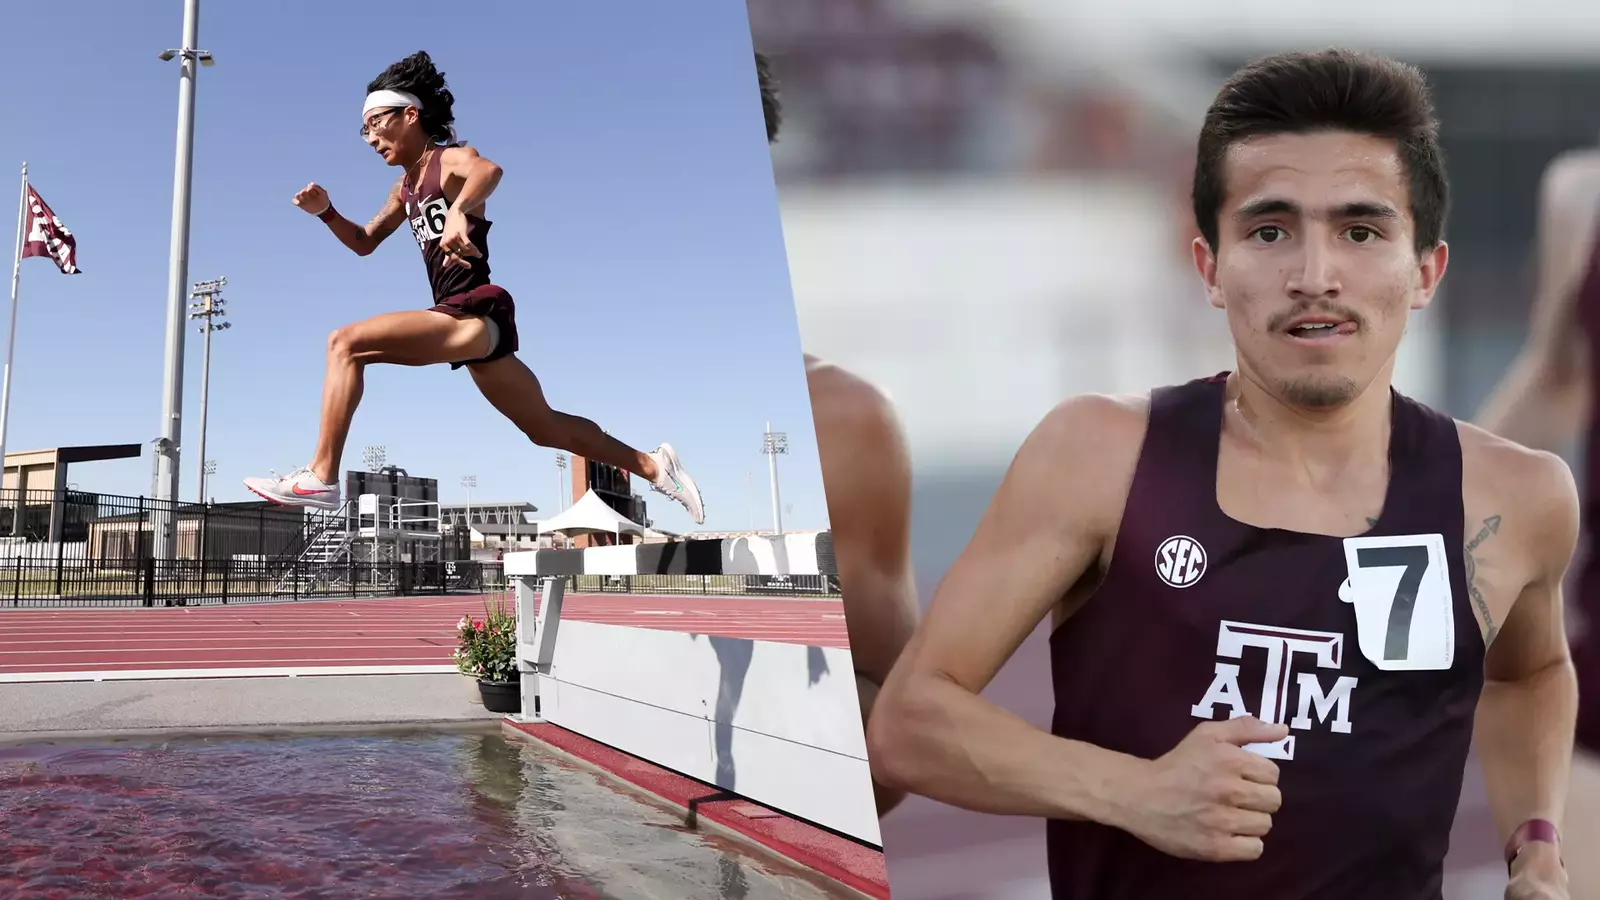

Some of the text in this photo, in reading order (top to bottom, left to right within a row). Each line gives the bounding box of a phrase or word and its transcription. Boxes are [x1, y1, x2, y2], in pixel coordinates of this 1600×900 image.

[425, 203, 446, 235] 6
[1157, 538, 1204, 585] SEC
[1356, 545, 1429, 660] 7
